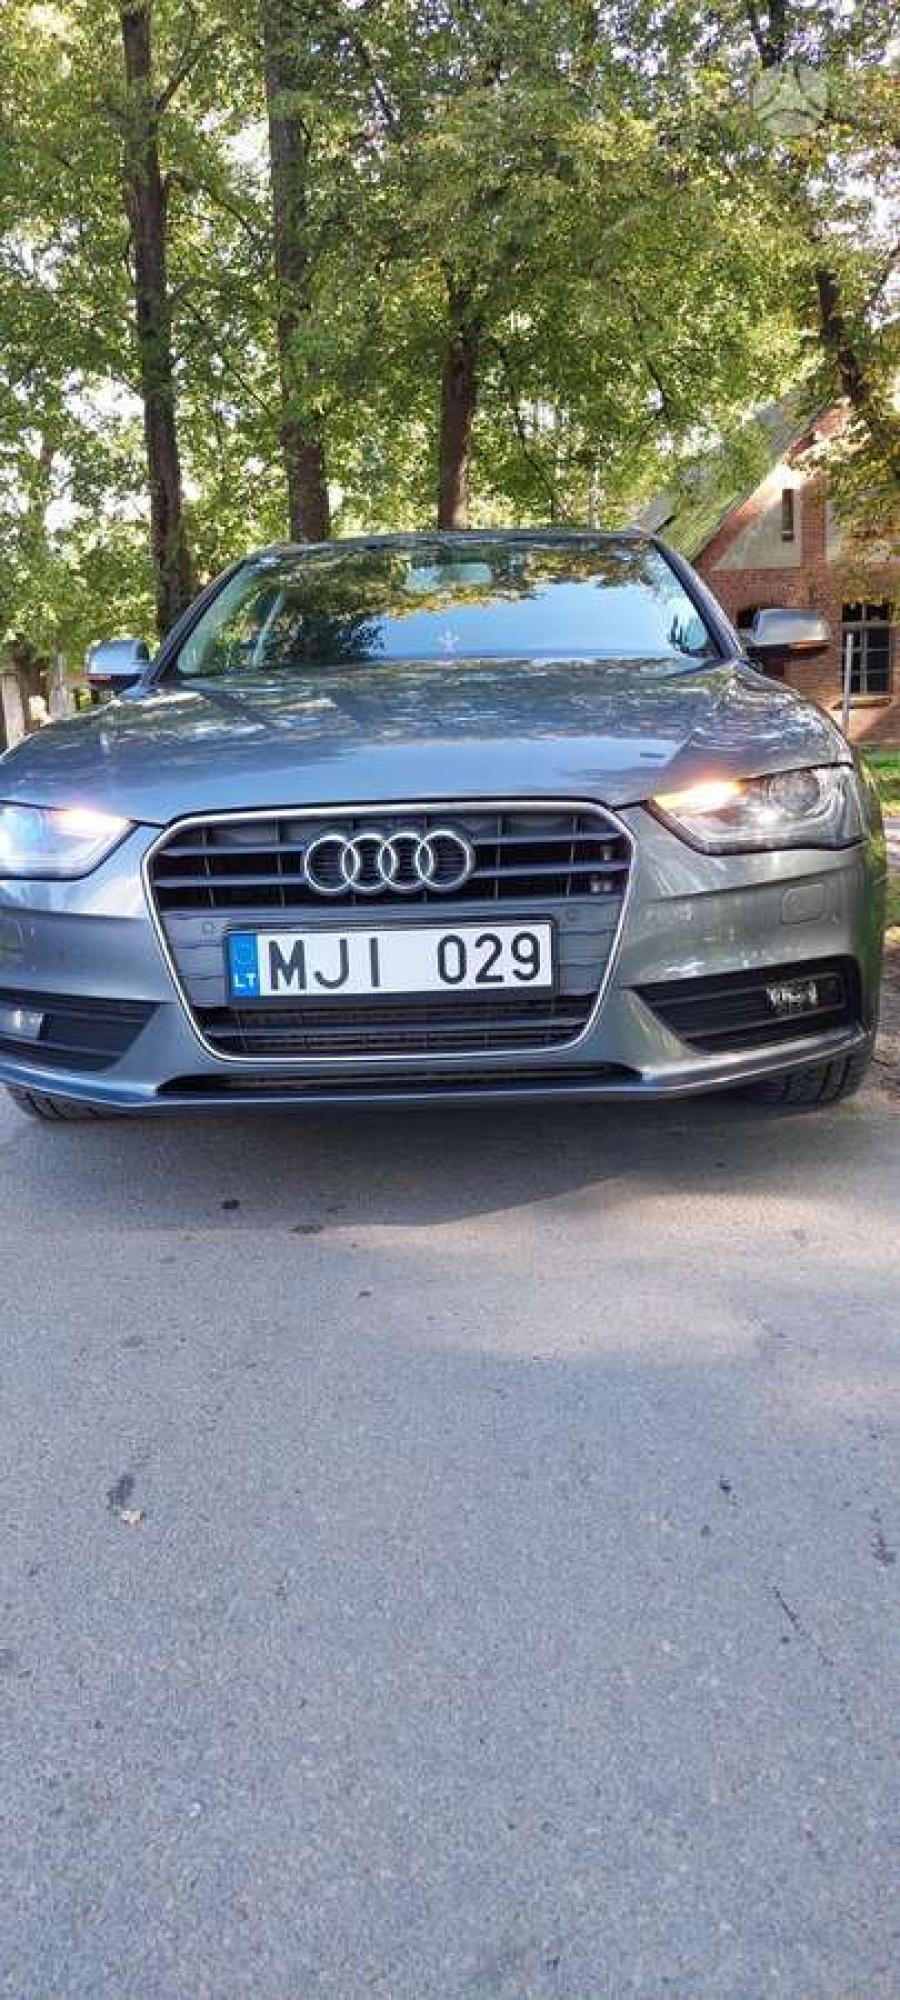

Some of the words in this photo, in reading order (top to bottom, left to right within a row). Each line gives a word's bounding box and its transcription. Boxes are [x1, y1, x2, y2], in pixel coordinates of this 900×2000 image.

[268, 938, 380, 991] MJI
[437, 932, 541, 985] 029
[234, 973, 256, 988] LT
